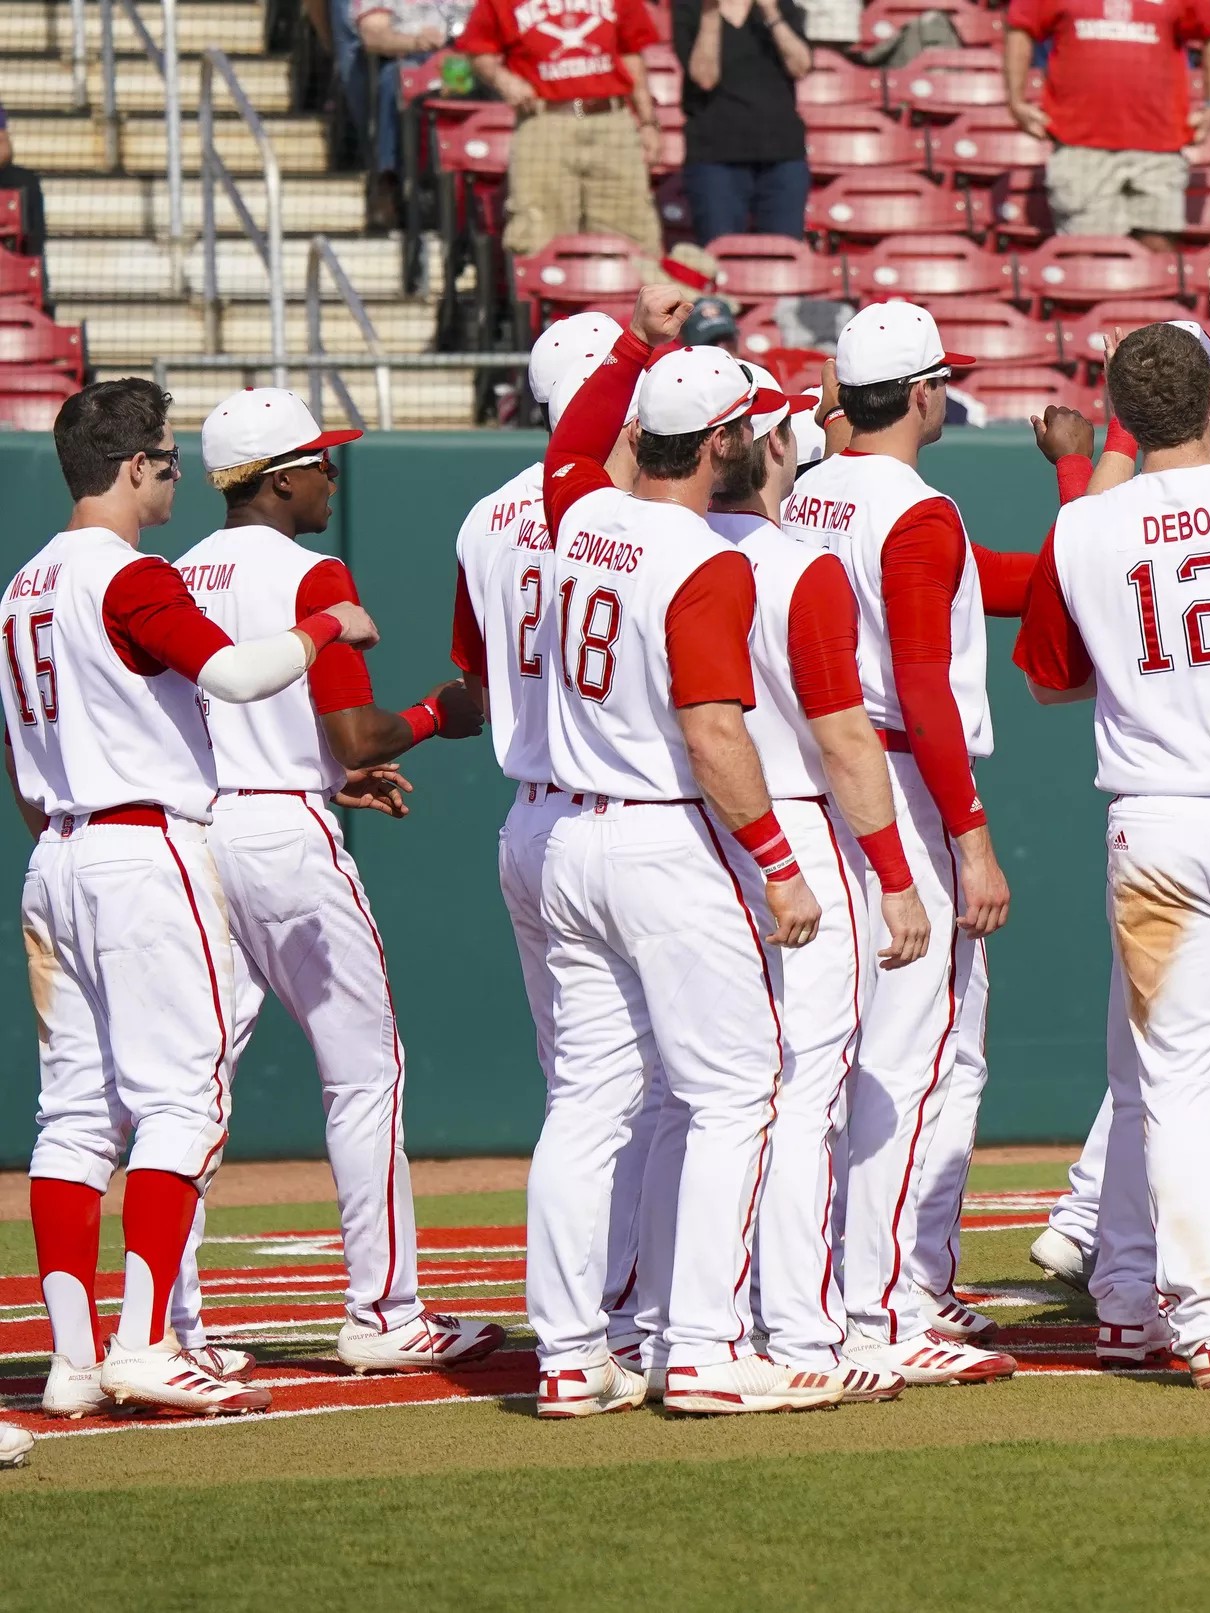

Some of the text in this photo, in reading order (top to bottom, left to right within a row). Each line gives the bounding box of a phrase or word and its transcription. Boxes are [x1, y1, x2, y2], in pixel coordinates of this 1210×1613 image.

[1143, 507, 1210, 544] DEBO
[567, 531, 643, 574] EDWARDS
[559, 576, 623, 704] 18
[2, 609, 59, 726] 15
[848, 1344, 882, 1354] WOLFPACK
